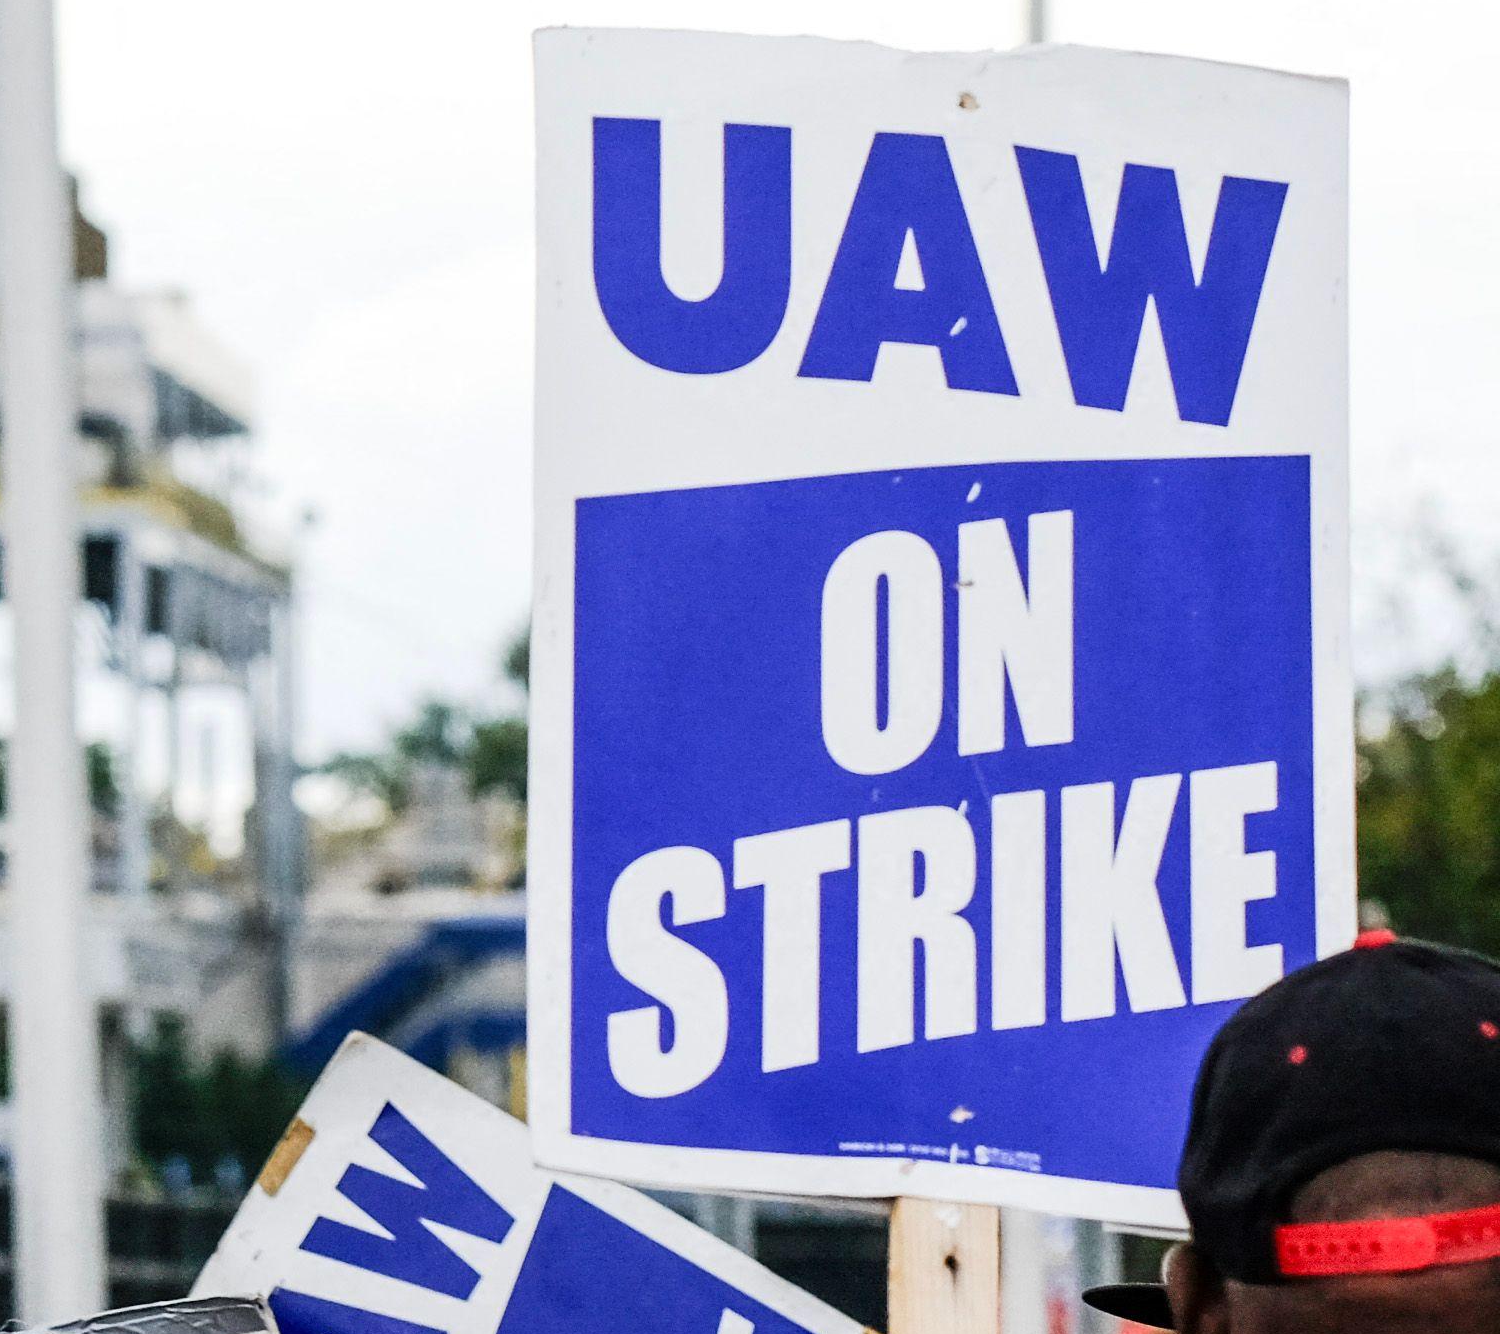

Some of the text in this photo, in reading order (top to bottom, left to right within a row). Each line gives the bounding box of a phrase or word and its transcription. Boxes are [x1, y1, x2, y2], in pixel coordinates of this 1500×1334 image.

[592, 116, 1291, 427] UAW
[820, 509, 1075, 776] ON
[606, 760, 1284, 1100] STRIKE
